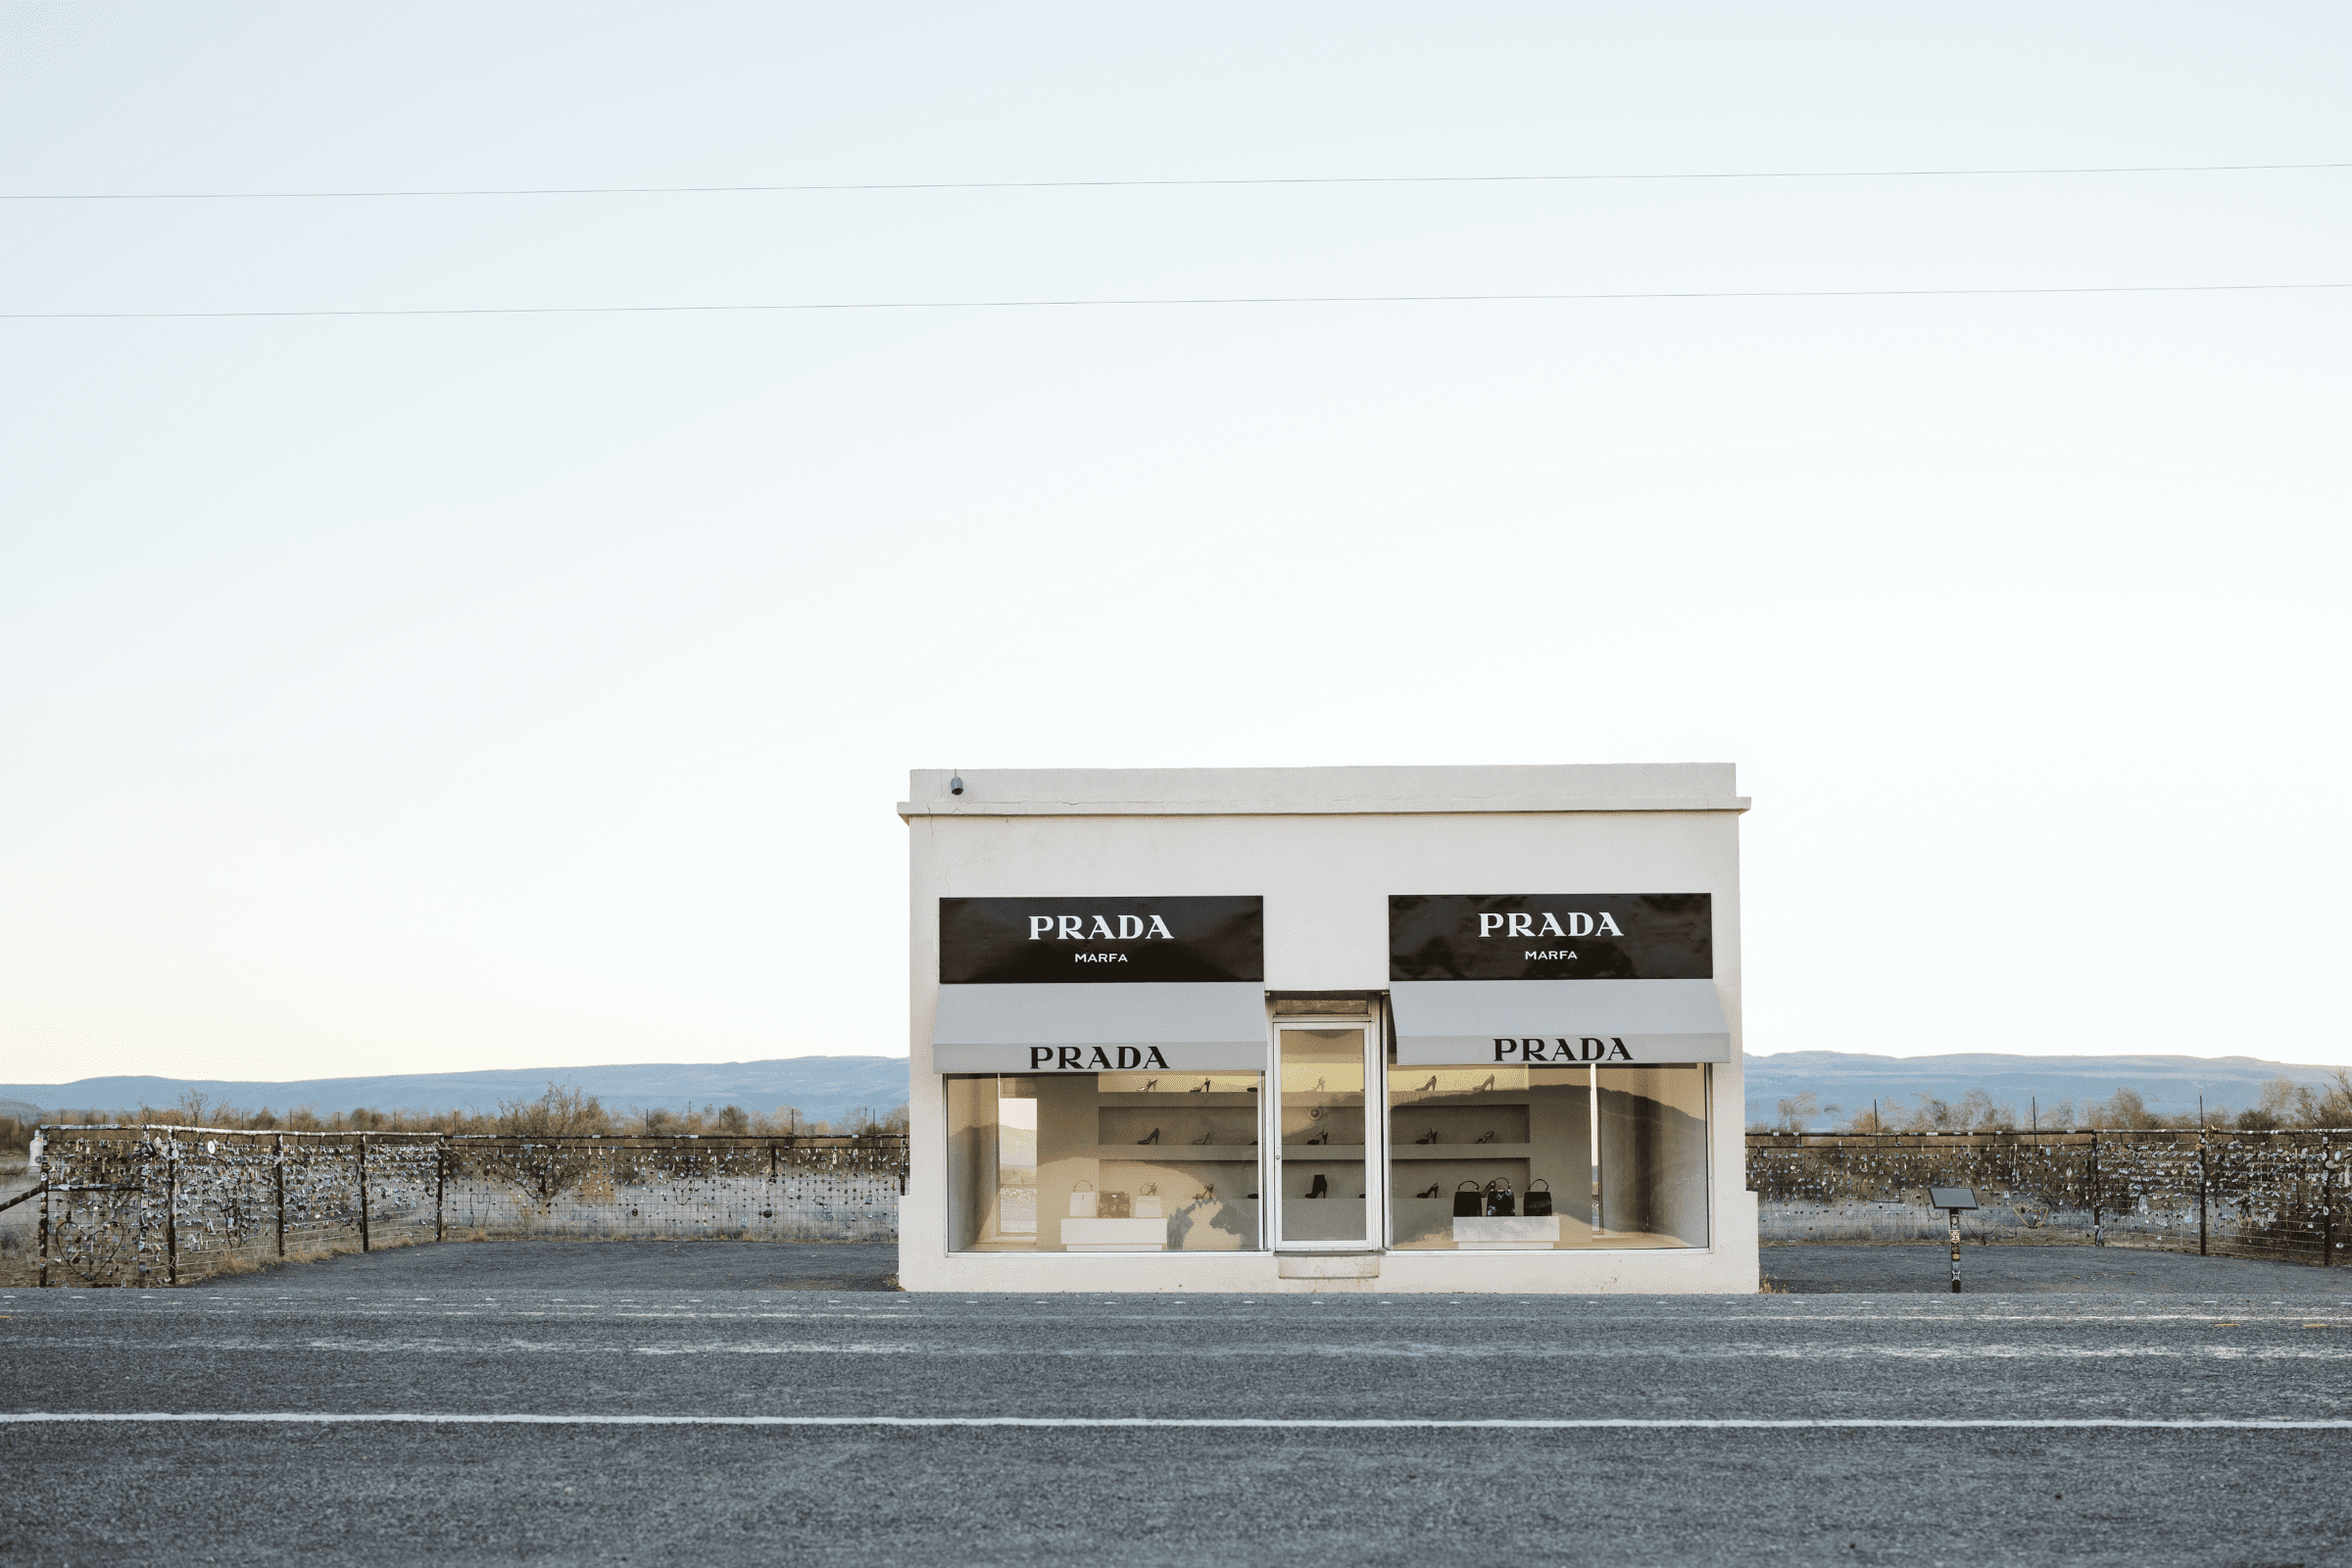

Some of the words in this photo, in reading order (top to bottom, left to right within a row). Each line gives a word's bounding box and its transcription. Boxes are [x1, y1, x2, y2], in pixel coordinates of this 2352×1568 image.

[1028, 914, 1175, 941] PRADA
[1478, 911, 1625, 938] PRADA
[1074, 953, 1128, 963] MARFA
[1525, 950, 1578, 960] MARFA
[1029, 1046, 1170, 1070] PRADA
[1493, 1037, 1634, 1062] PRADA
